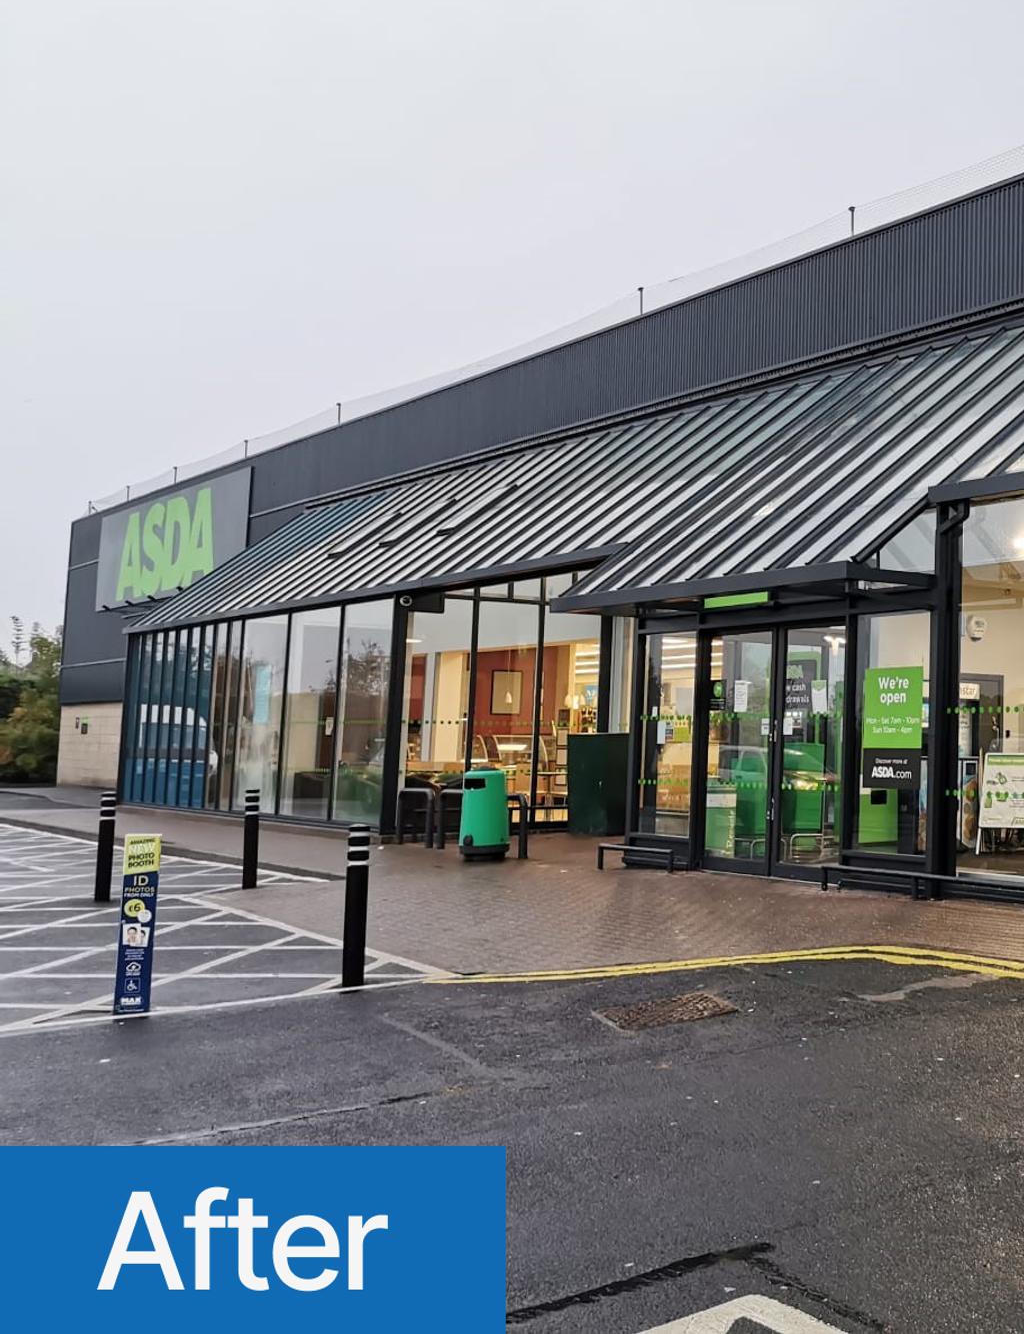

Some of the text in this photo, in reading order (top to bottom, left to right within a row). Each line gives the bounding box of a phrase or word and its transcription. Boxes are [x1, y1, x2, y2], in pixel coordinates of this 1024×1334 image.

[115, 487, 214, 602] ASDA
[878, 676, 909, 690] We're
[880, 692, 906, 706] open
[871, 765, 912, 779] ASDA.com
[128, 852, 155, 861] PHOTO
[128, 859, 154, 868] BOOTH
[133, 875, 149, 886] ID
